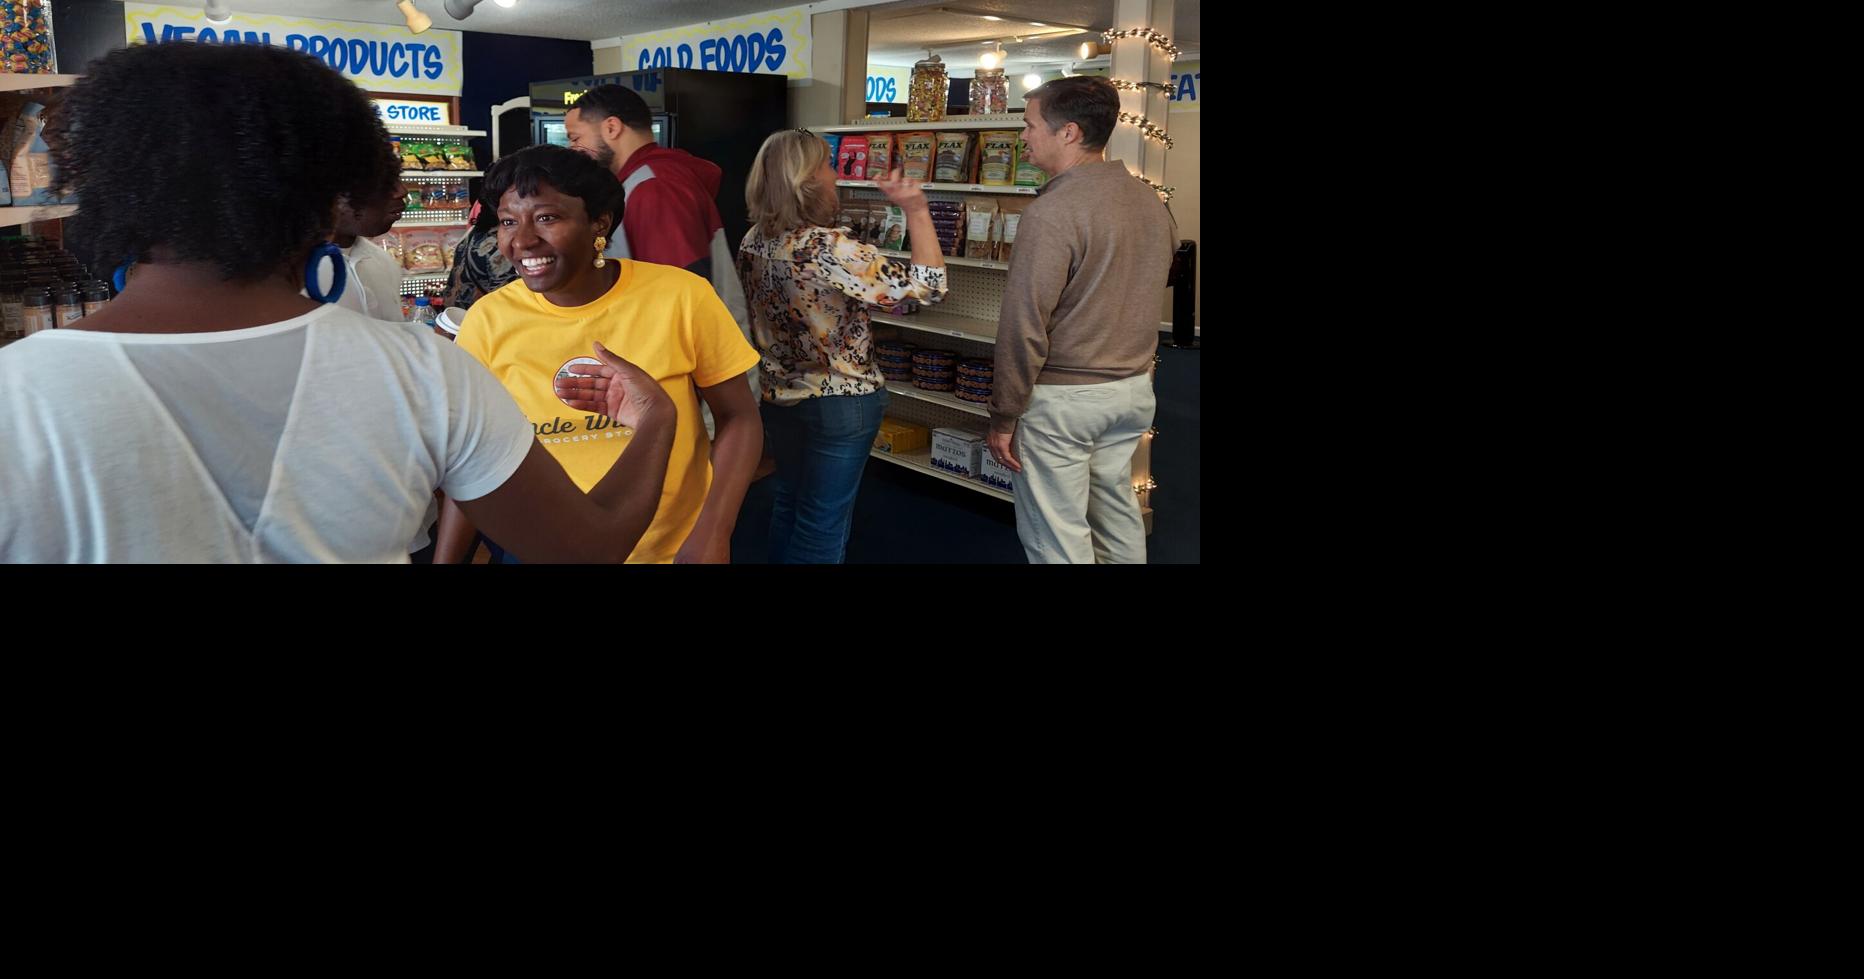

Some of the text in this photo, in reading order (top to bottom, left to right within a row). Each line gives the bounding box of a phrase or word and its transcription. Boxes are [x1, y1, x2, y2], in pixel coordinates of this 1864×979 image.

[286, 34, 444, 80] PRODUCTS
[699, 27, 787, 73] FOODS
[386, 105, 441, 121] STORE
[530, 416, 576, 435] ncle
[543, 430, 633, 444] ROCERY STO
